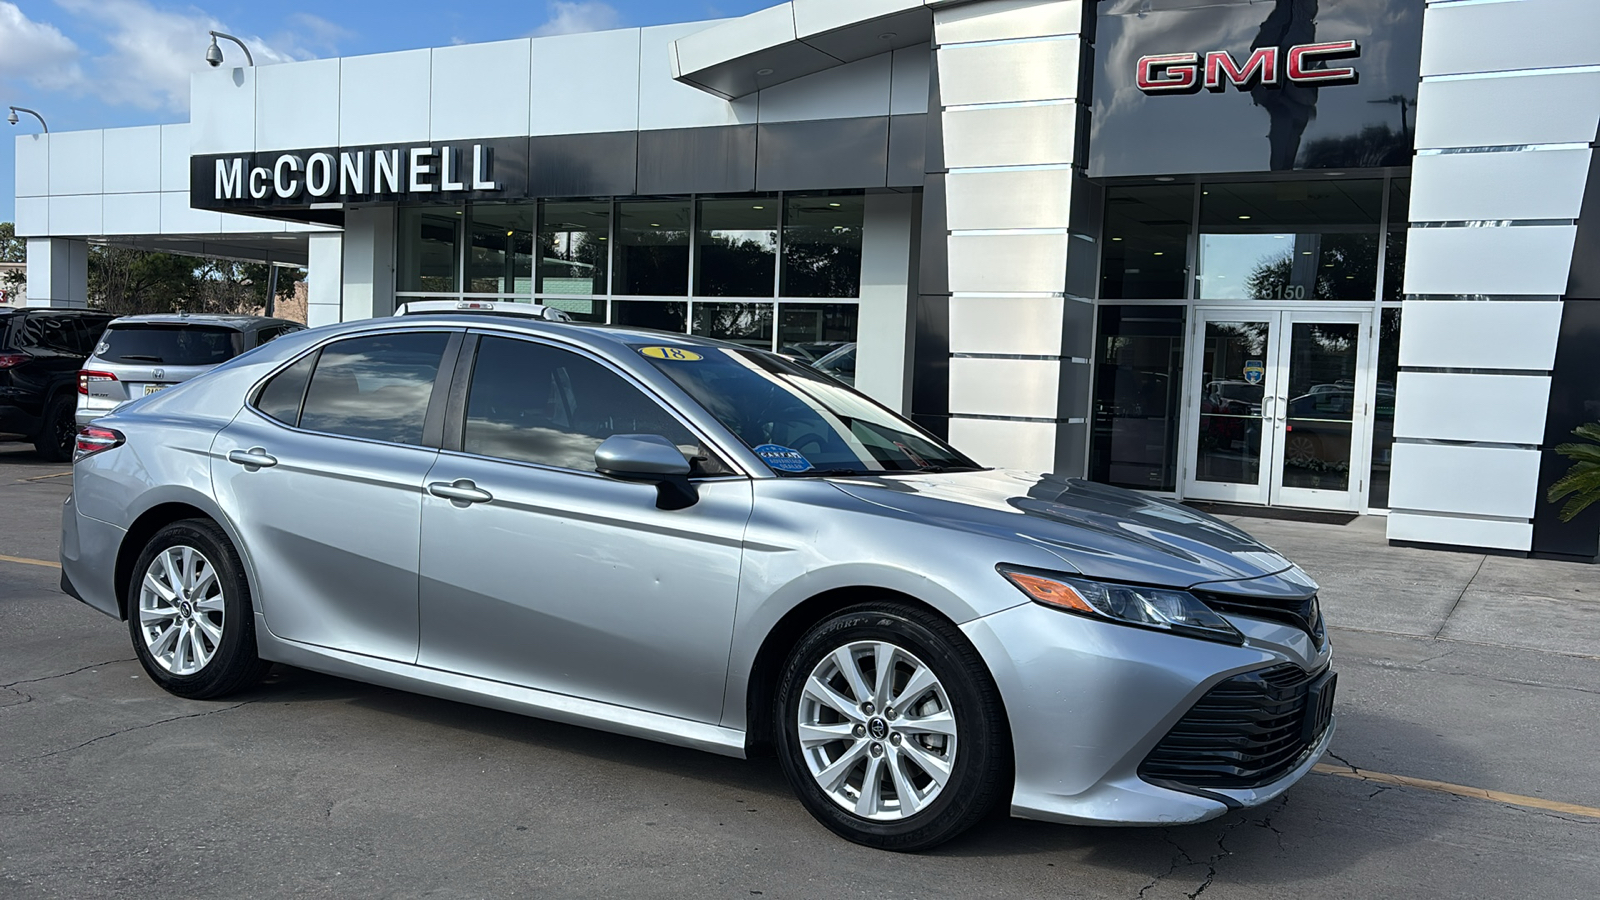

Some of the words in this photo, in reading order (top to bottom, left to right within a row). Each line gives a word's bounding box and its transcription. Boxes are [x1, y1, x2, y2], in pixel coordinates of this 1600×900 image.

[1135, 40, 1357, 91] GMC
[214, 144, 497, 200] McCONNELL
[658, 347, 686, 359] 18
